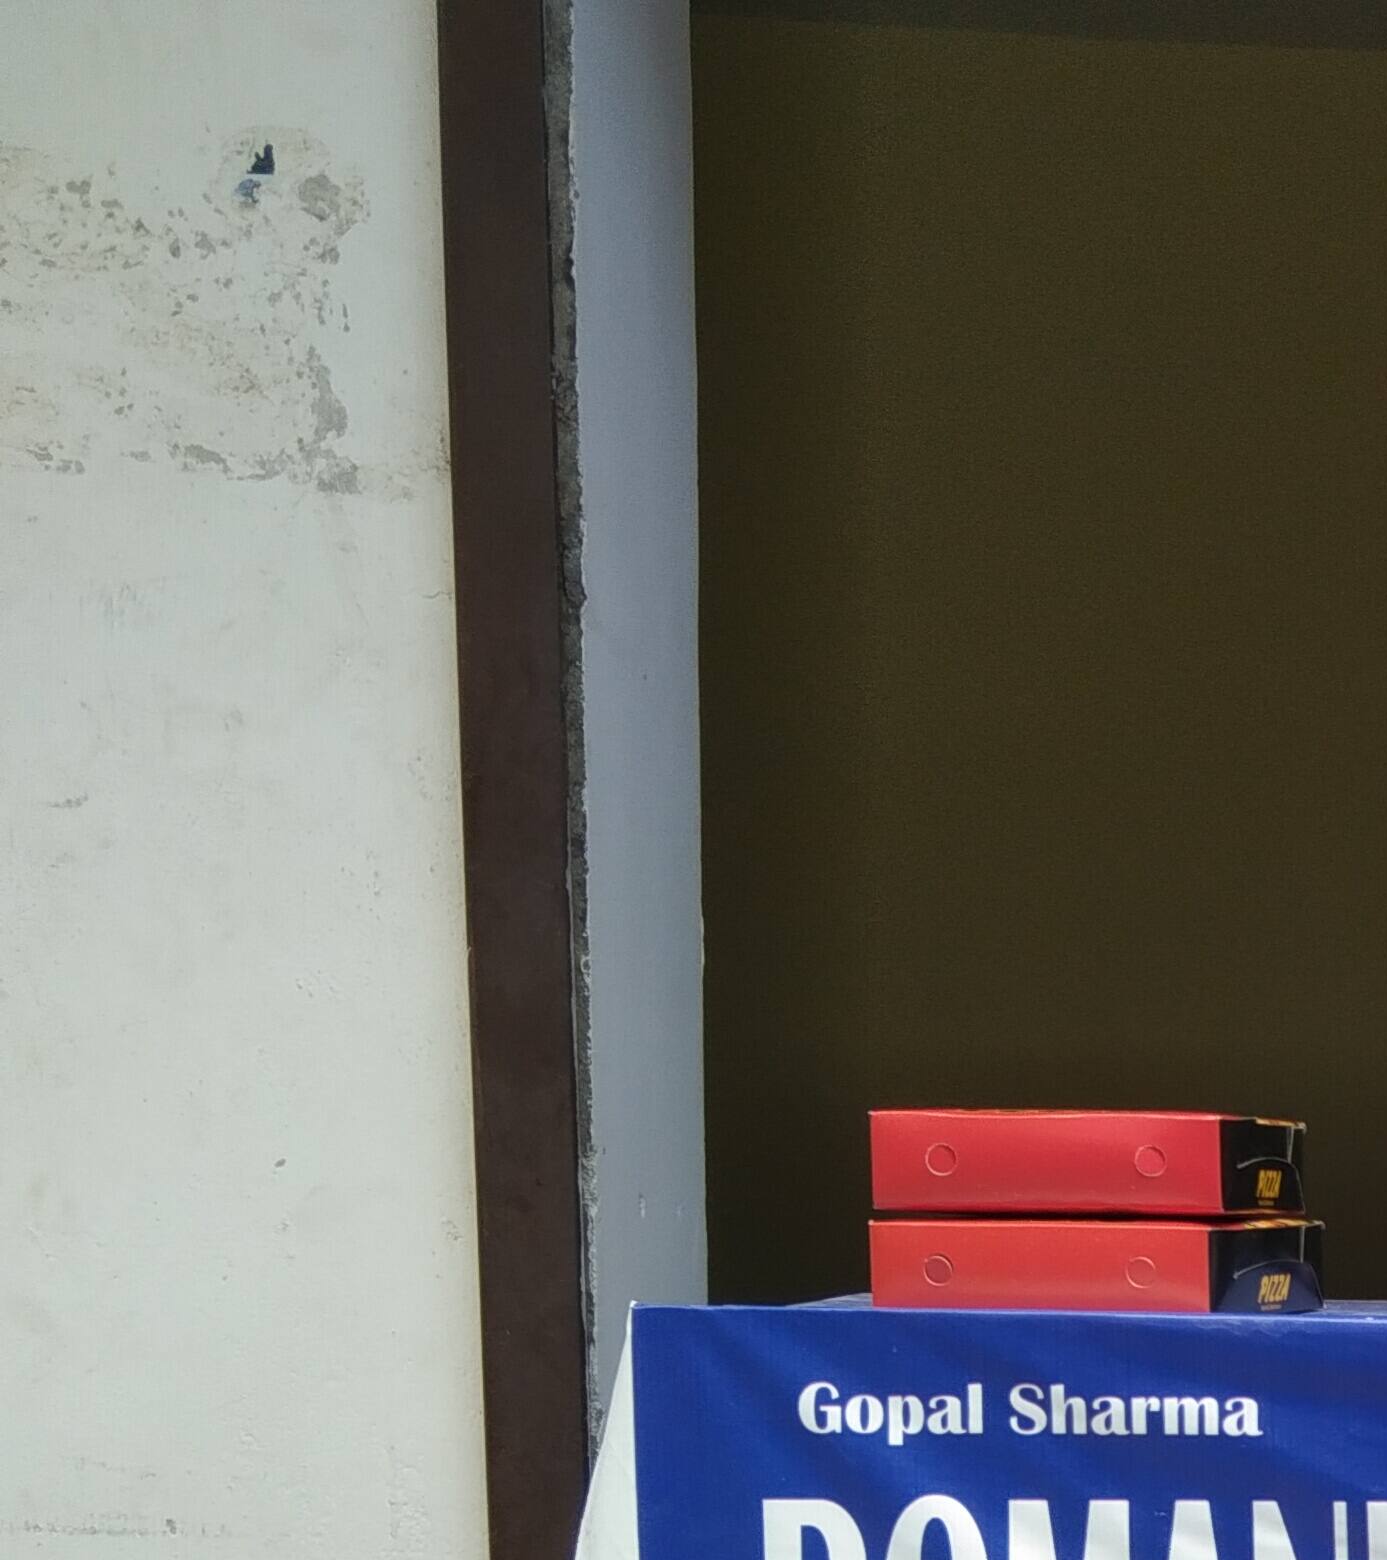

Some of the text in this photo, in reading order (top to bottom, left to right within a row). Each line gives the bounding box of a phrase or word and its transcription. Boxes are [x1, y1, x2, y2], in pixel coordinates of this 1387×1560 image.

[1258, 1273, 1291, 1304] PIZZA
[798, 1381, 1264, 1446] Gopal Sharma
